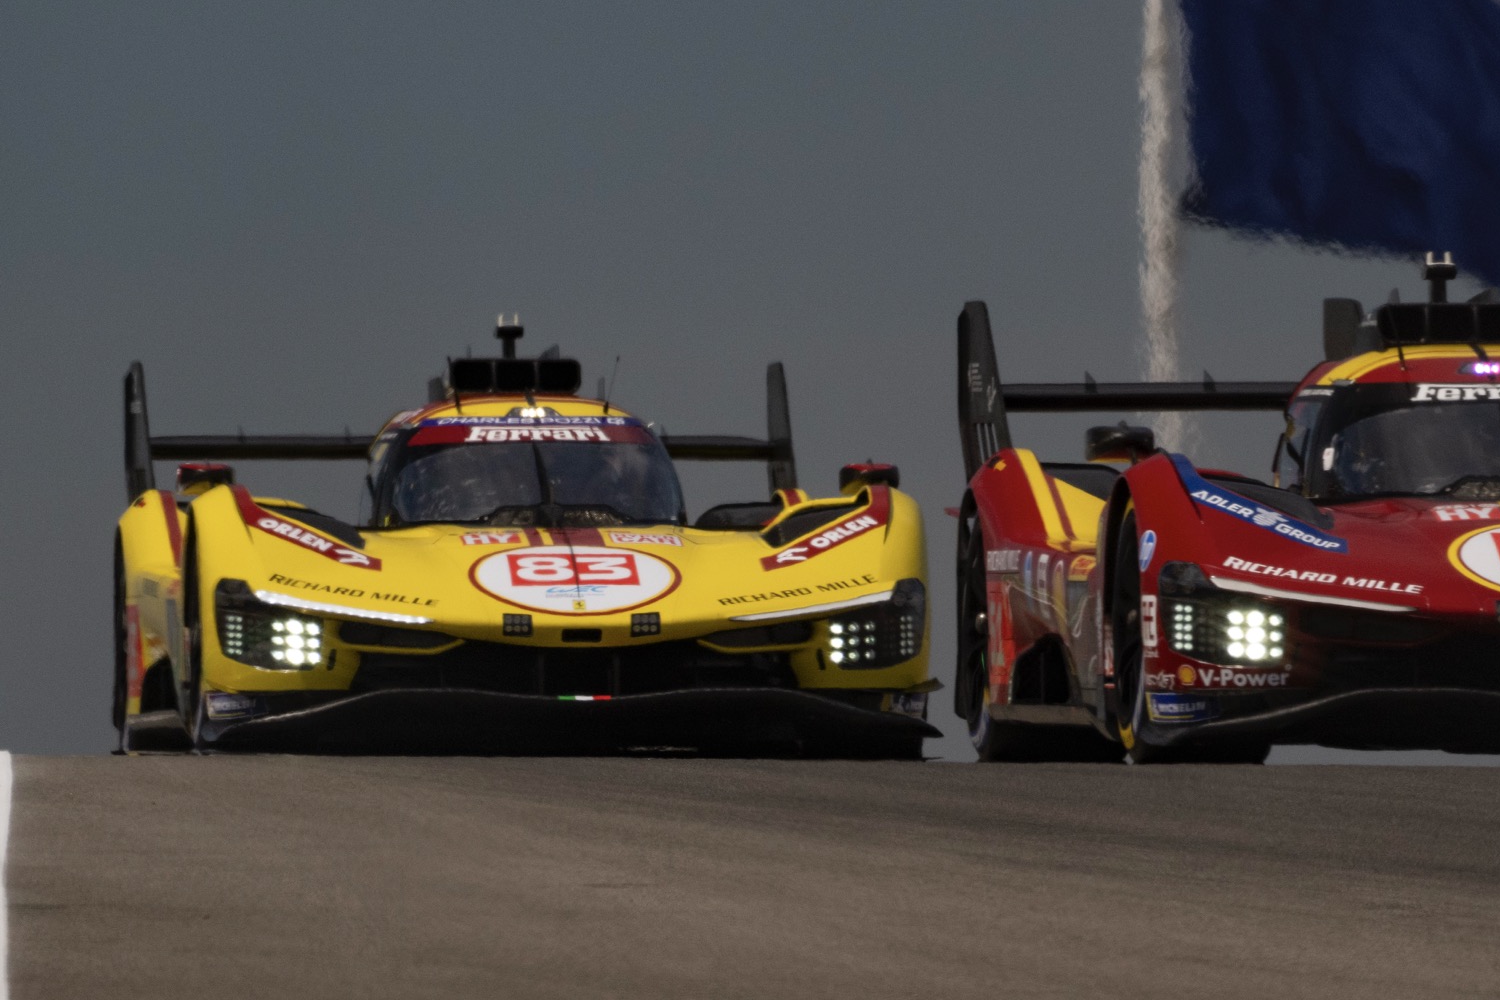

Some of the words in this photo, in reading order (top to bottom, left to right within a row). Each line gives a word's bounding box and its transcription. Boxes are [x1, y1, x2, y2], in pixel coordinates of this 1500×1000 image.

[463, 425, 611, 442] Ferrari
[1190, 490, 1255, 518] ADLER
[1274, 523, 1340, 548] GROUP
[1436, 507, 1494, 521] HY
[257, 518, 333, 552] ORLEN
[463, 533, 514, 545] HY
[809, 515, 878, 548] ORLEN
[515, 556, 632, 582] 83
[1222, 556, 1338, 583] RICHARD
[1342, 577, 1424, 594] MILLE
[268, 573, 365, 598] RICHARD
[370, 592, 439, 607] MILLE
[718, 587, 812, 606] RICHARD
[816, 574, 878, 593] MILLE
[1198, 668, 1289, 687] V-Power
